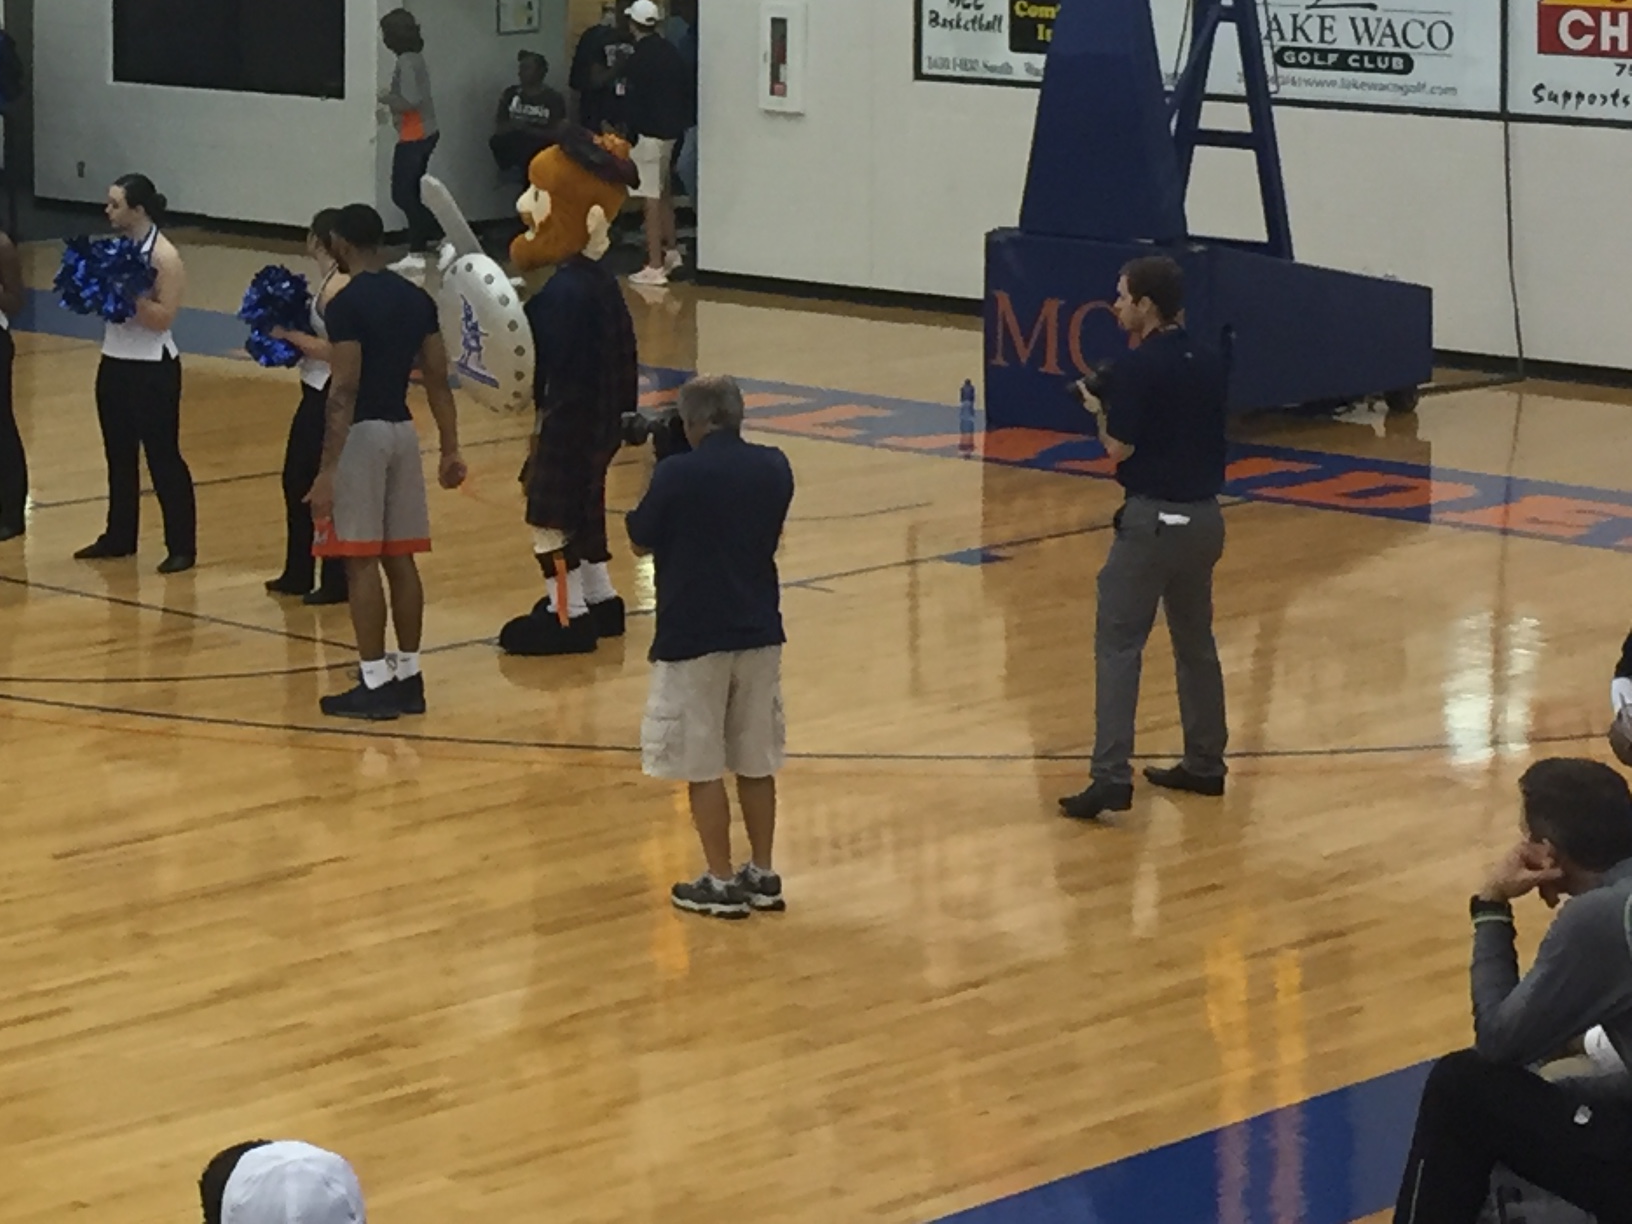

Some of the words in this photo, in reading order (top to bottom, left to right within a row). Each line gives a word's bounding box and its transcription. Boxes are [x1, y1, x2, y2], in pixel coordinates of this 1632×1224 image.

[928, 9, 1004, 33] Basketball
[1262, 12, 1338, 45] AKE
[1348, 15, 1455, 51] WACO
[1558, 8, 1630, 53] CH
[1282, 51, 1340, 66] GOLF
[1347, 54, 1406, 71] CLUB
[1531, 82, 1631, 111] Supports
